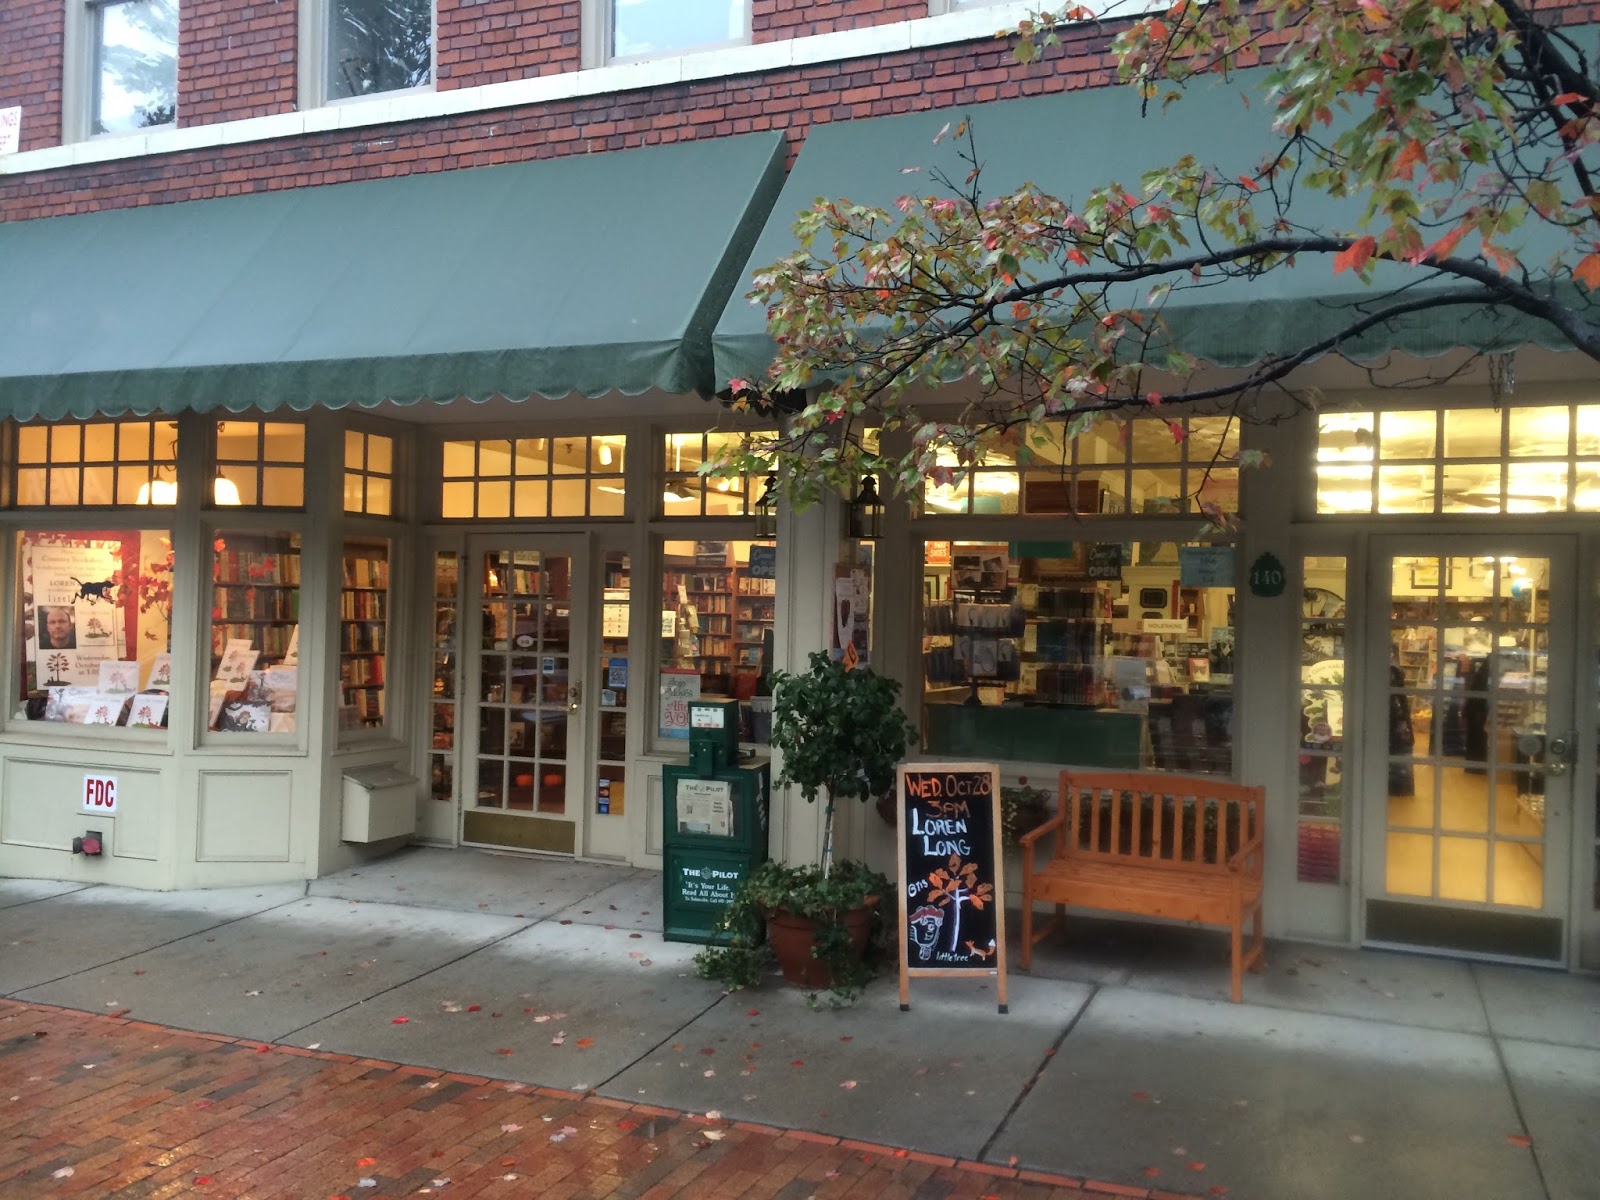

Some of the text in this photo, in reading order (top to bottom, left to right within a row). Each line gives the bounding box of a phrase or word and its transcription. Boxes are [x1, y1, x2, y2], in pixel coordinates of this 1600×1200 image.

[752, 565, 776, 576] OPE
[1088, 566, 1117, 577] OPEN
[1254, 570, 1282, 585] 140
[665, 701, 688, 712] Aft
[665, 712, 689, 727] YO
[973, 774, 993, 796] 28
[86, 778, 115, 808] FDC
[912, 807, 968, 836] LOREN
[923, 835, 971, 857] LONG
[682, 867, 739, 879] THE PILOT
[681, 888, 697, 896] Read
[700, 882, 715, 890] Your
